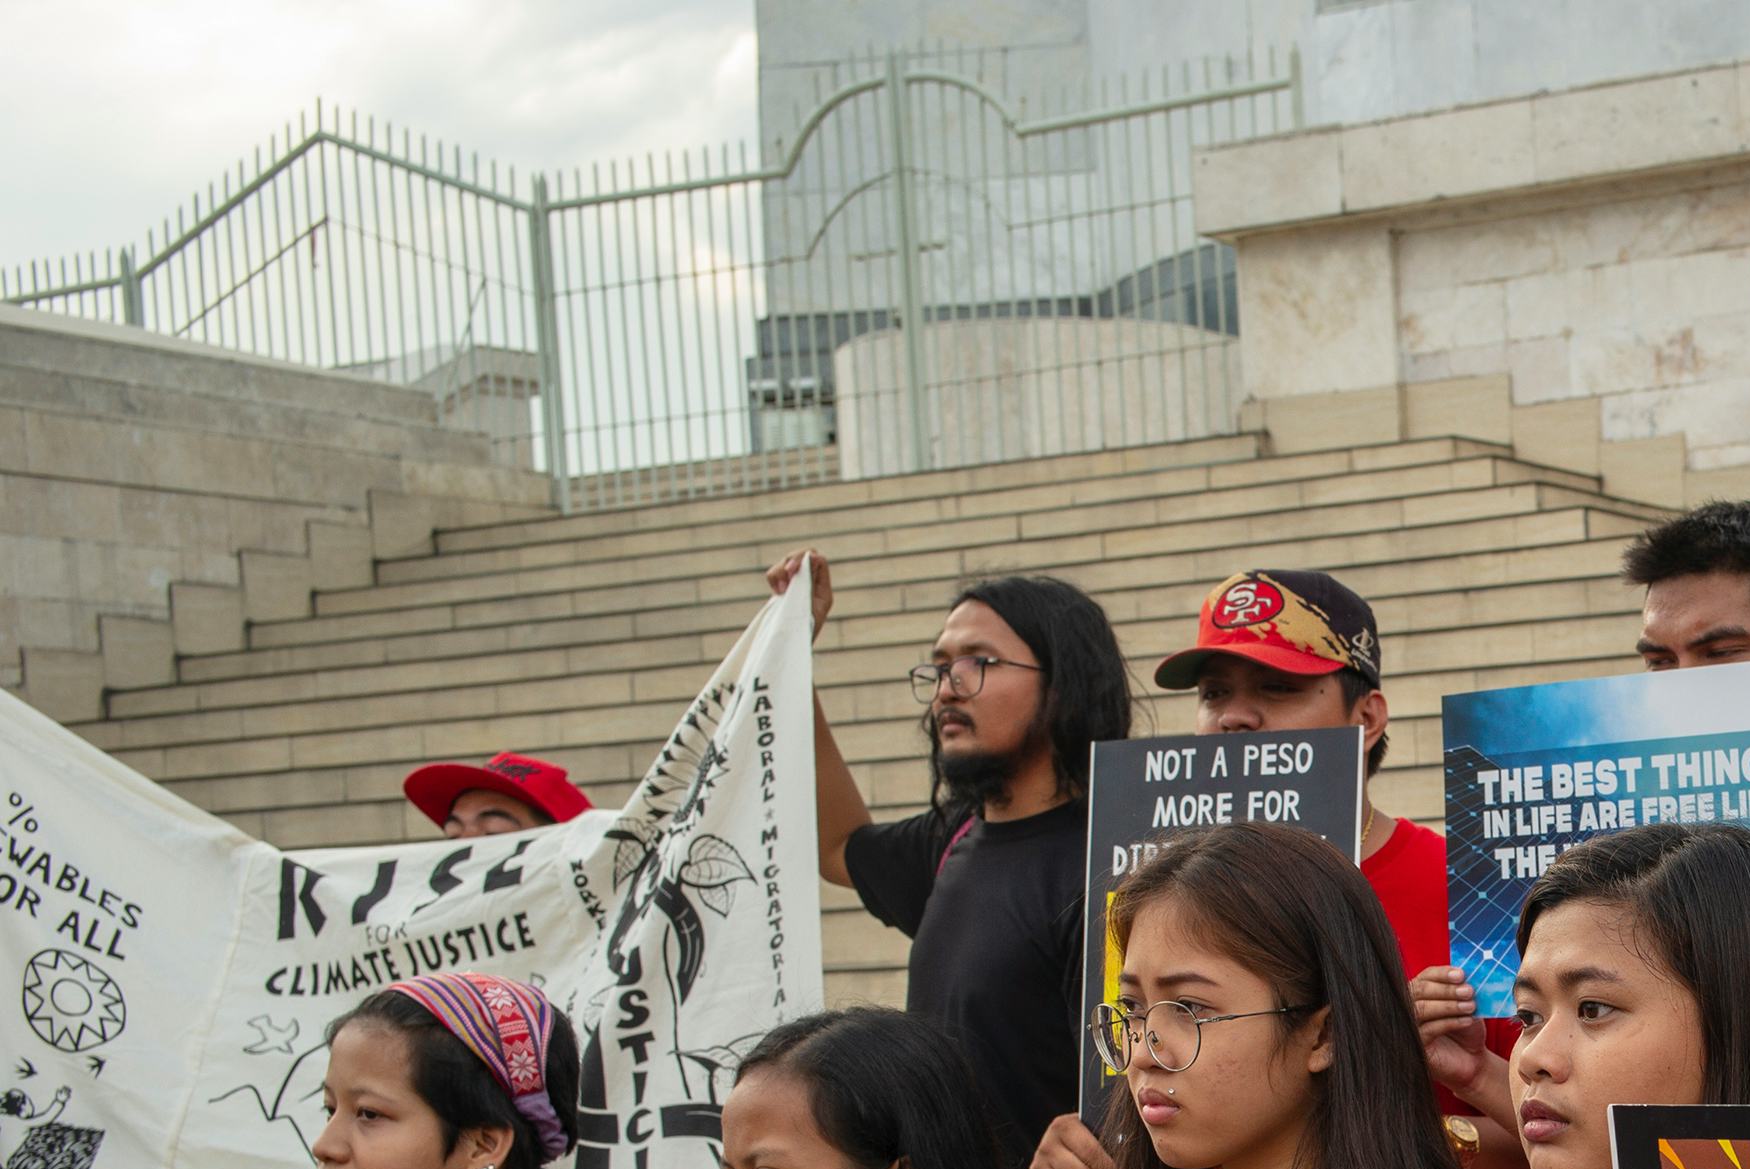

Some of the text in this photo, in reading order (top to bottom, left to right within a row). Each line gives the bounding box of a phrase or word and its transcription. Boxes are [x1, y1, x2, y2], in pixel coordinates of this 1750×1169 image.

[753, 677, 776, 802] LABORAL
[1145, 742, 1315, 782] NOT A PESO
[1477, 766, 1543, 805] THE
[1552, 757, 1642, 798] BEST
[1152, 790, 1301, 828] MORE FOR
[1483, 810, 1511, 839] IN
[1515, 804, 1573, 836] LIFE
[1579, 798, 1636, 832] ARE
[1642, 793, 1718, 828] FREE
[0, 827, 143, 929] WABLES
[1112, 842, 1172, 877] DIR
[1494, 844, 1556, 880] THE
[56, 910, 126, 961] ALL
[762, 825, 787, 1008] MIGRATORIA
[265, 911, 535, 996] CLIMATE JUSTICE
